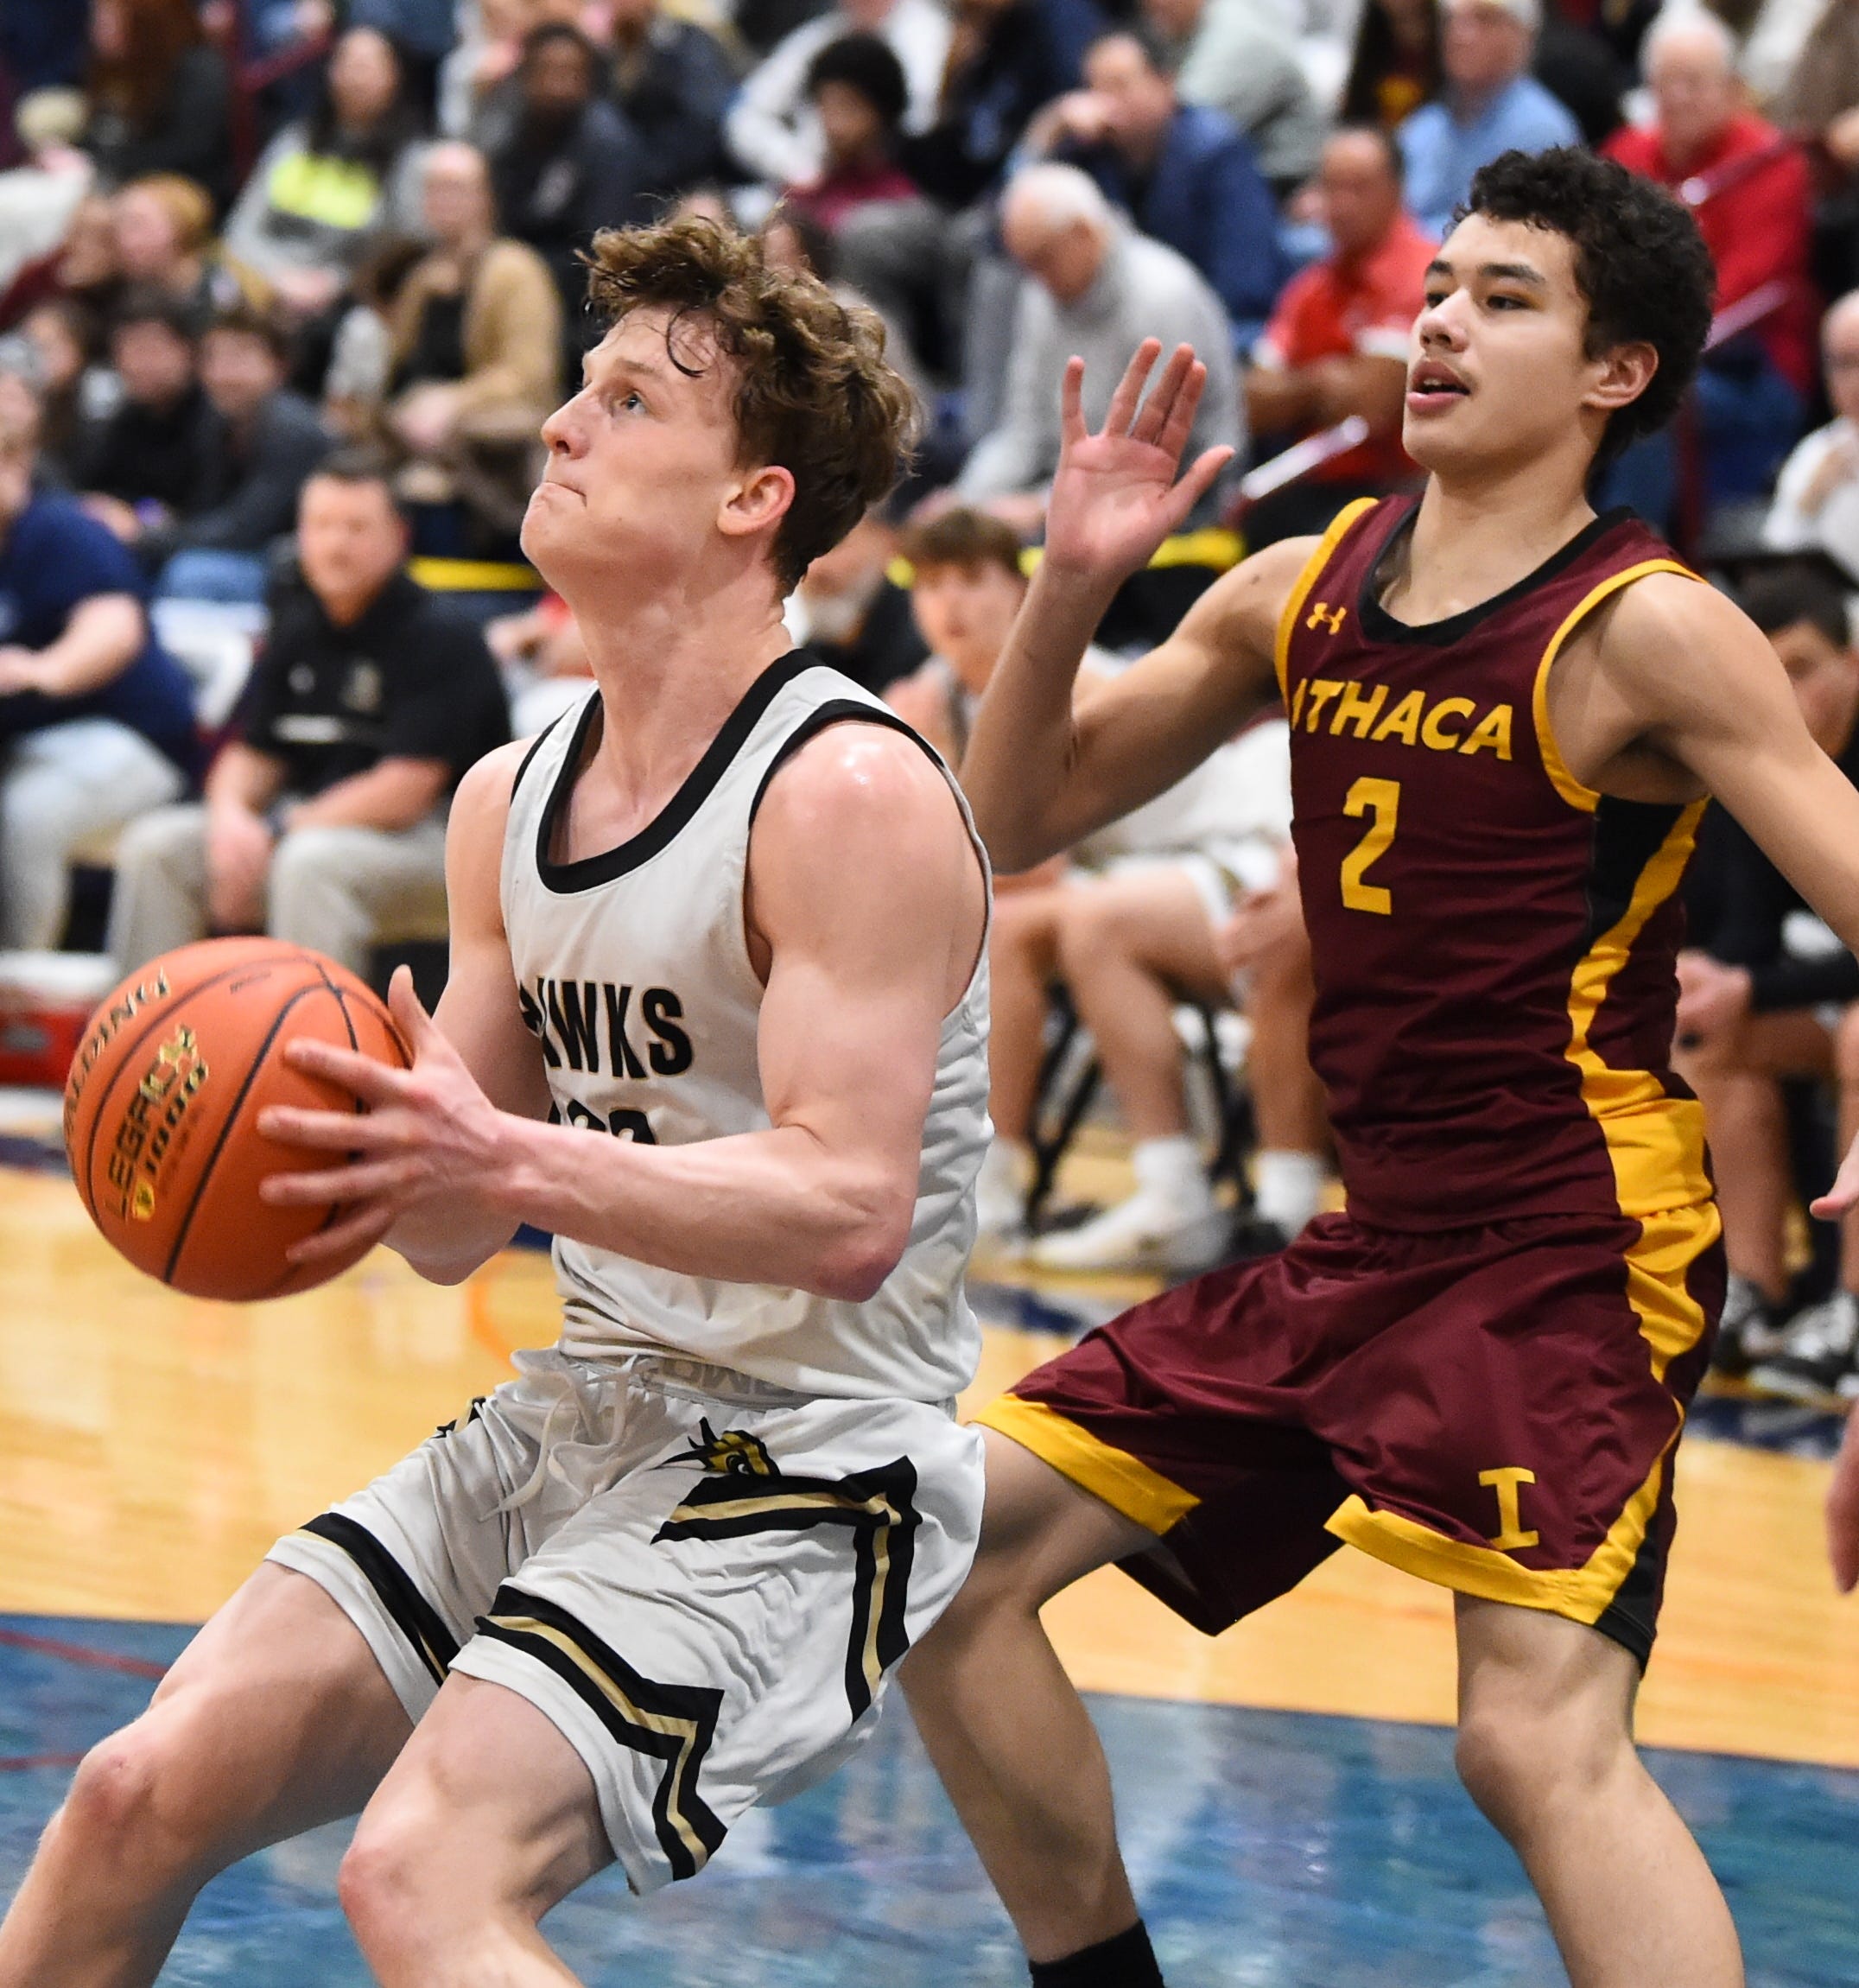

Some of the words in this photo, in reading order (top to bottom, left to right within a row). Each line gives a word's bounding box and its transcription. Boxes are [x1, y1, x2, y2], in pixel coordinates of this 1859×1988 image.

[1291, 677, 1513, 761] ITHACA
[1340, 777, 1400, 916] 2
[1478, 1466, 1539, 1550] I
